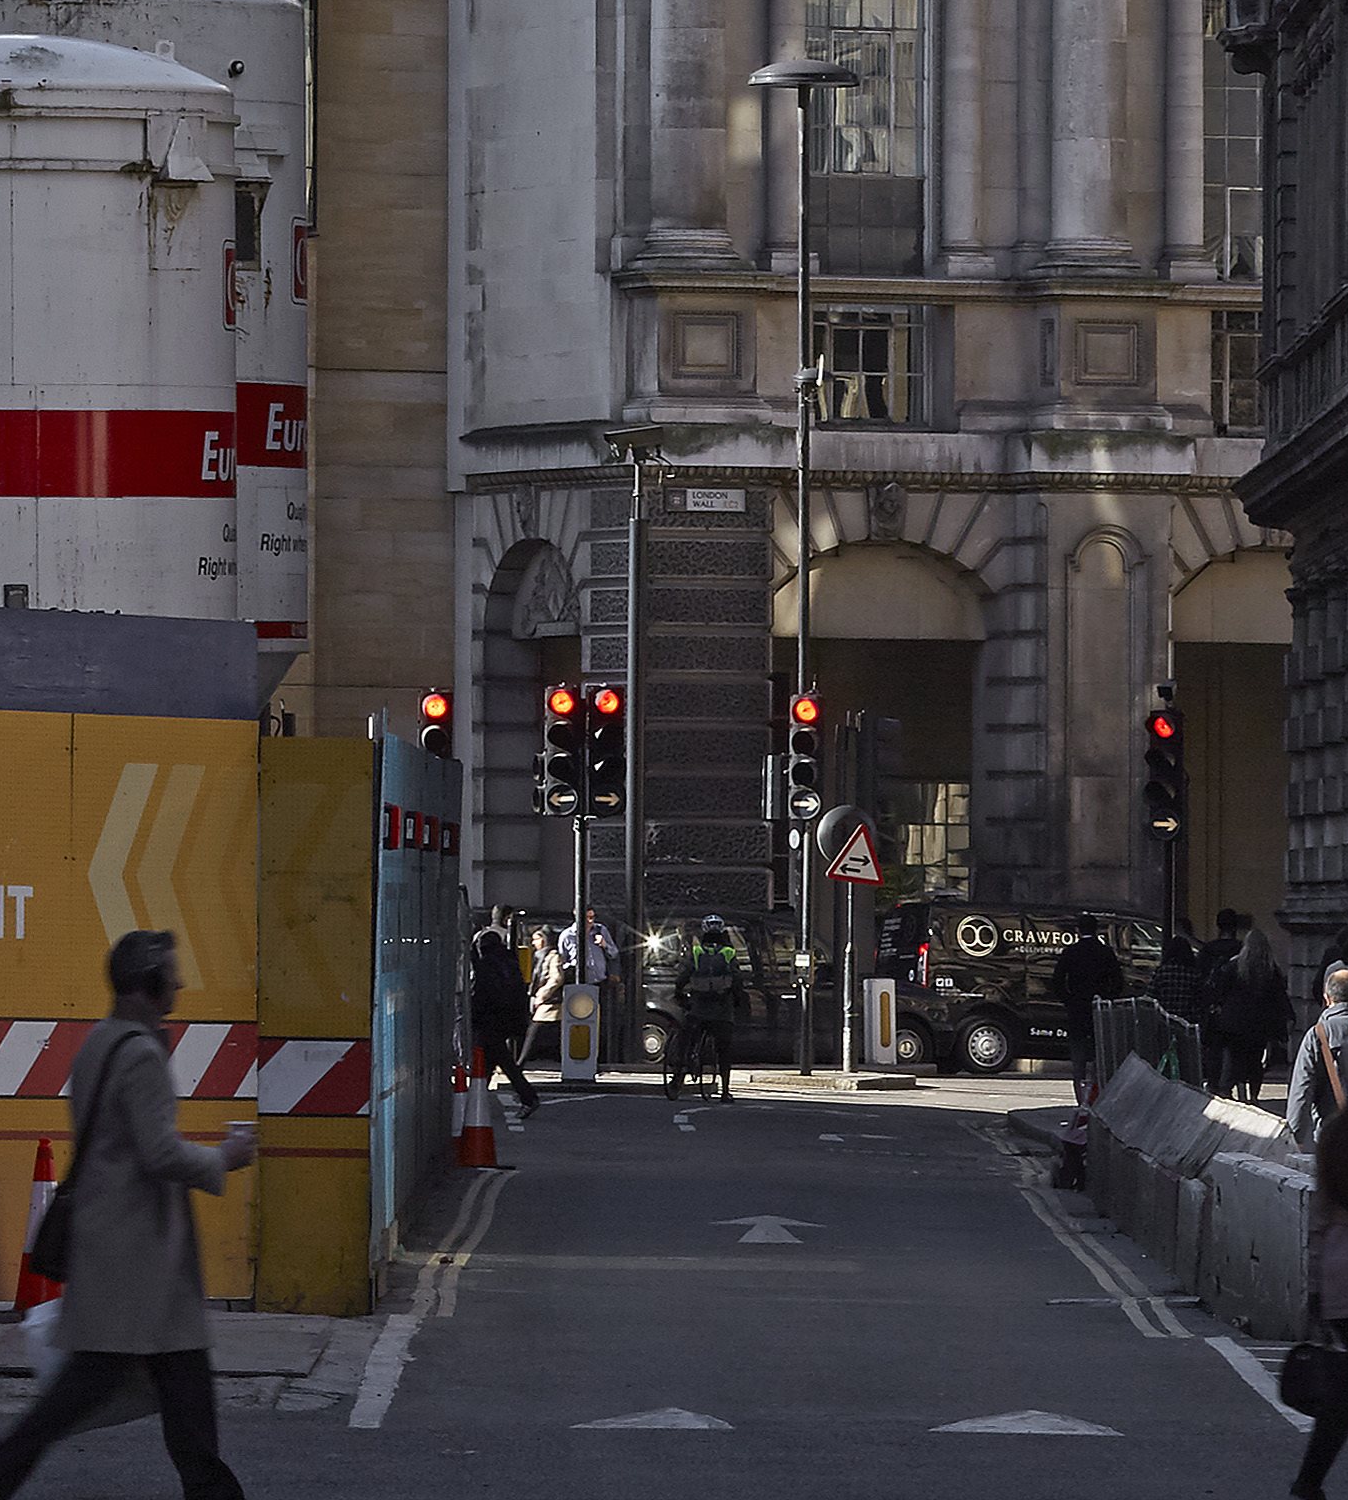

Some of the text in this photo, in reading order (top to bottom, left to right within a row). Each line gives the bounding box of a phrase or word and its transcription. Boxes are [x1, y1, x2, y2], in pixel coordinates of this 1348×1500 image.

[693, 491, 728, 500] LONDON
[693, 500, 717, 508] WALL
[260, 533, 291, 556] Right
[198, 556, 227, 580] Right
[1056, 1028, 1068, 1037] Da
